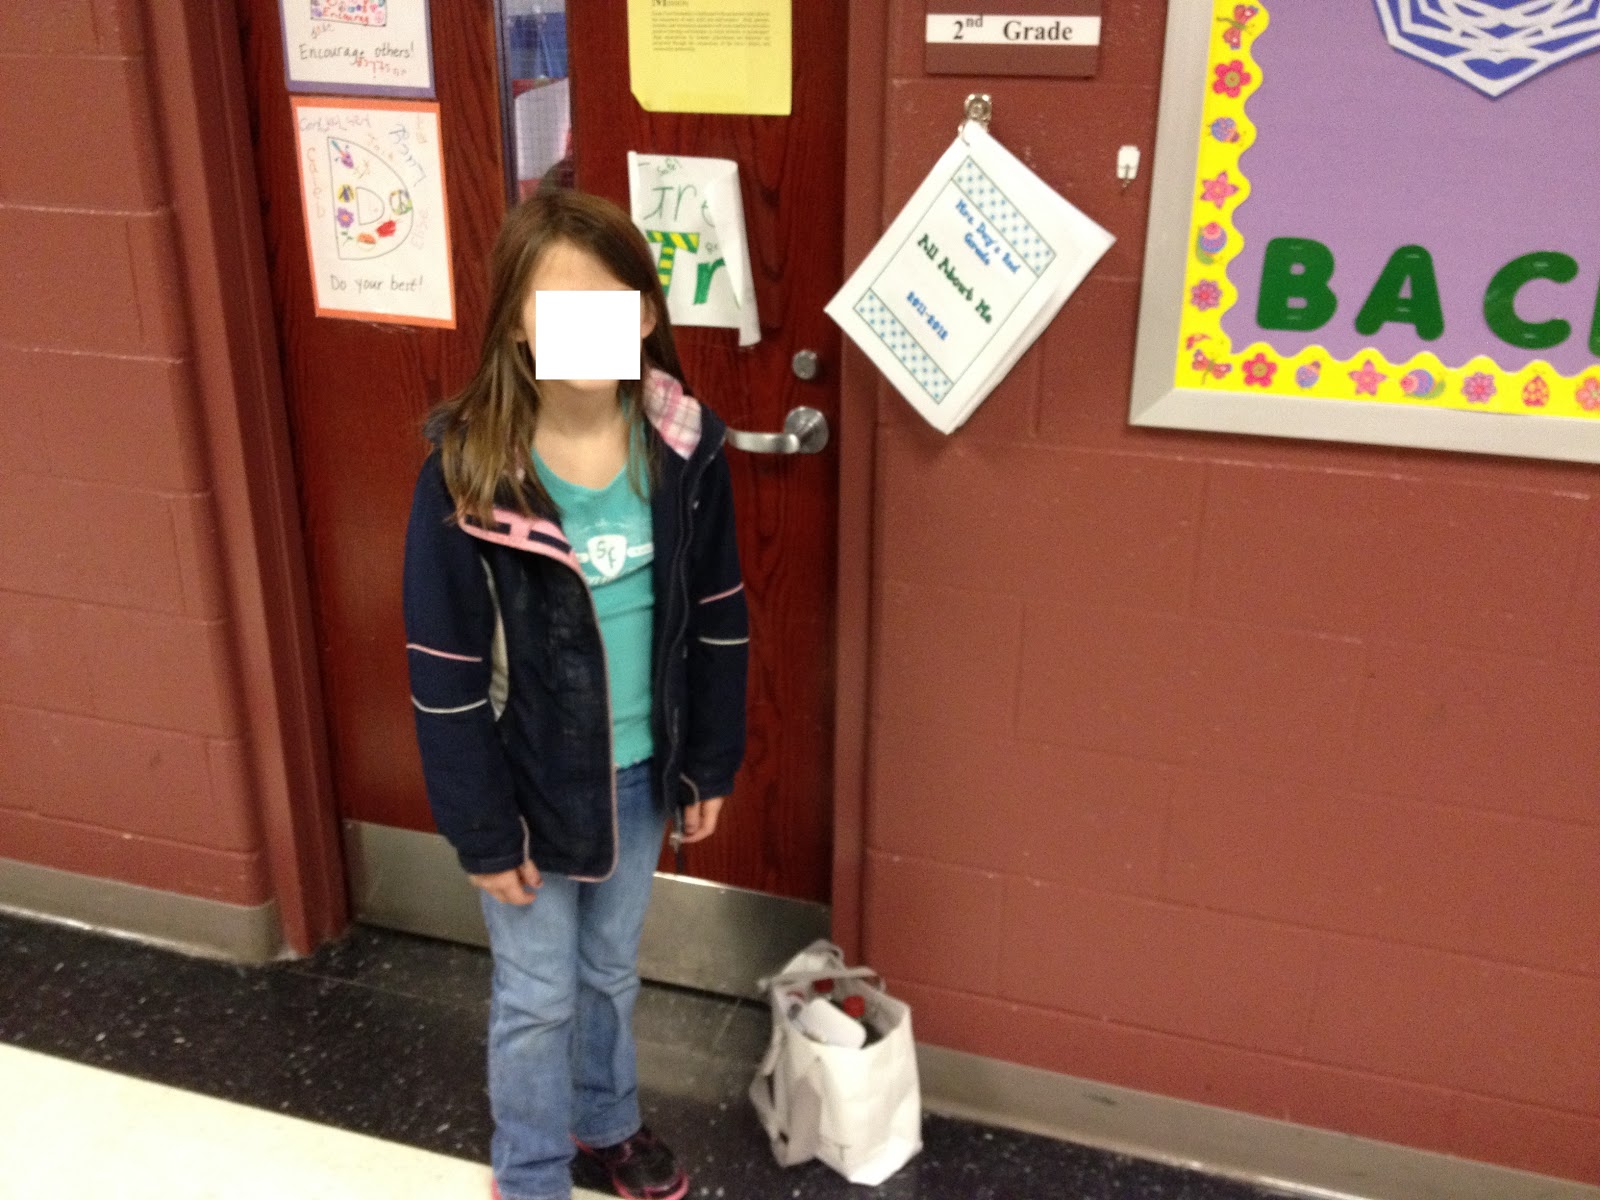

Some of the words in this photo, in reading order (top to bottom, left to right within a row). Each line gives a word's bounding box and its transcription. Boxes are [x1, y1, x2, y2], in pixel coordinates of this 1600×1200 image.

[953, 15, 984, 40] 2nd
[1003, 20, 1073, 41] Grade
[299, 43, 365, 62] Encourage
[375, 41, 414, 58] others!
[330, 274, 347, 292] Do
[355, 277, 383, 294] your
[390, 275, 423, 293] best!
[917, 233, 939, 261] All
[937, 256, 974, 302] About
[975, 299, 992, 324] Me
[1256, 236, 1600, 358] BAC
[906, 291, 949, 341] 2011-2012
